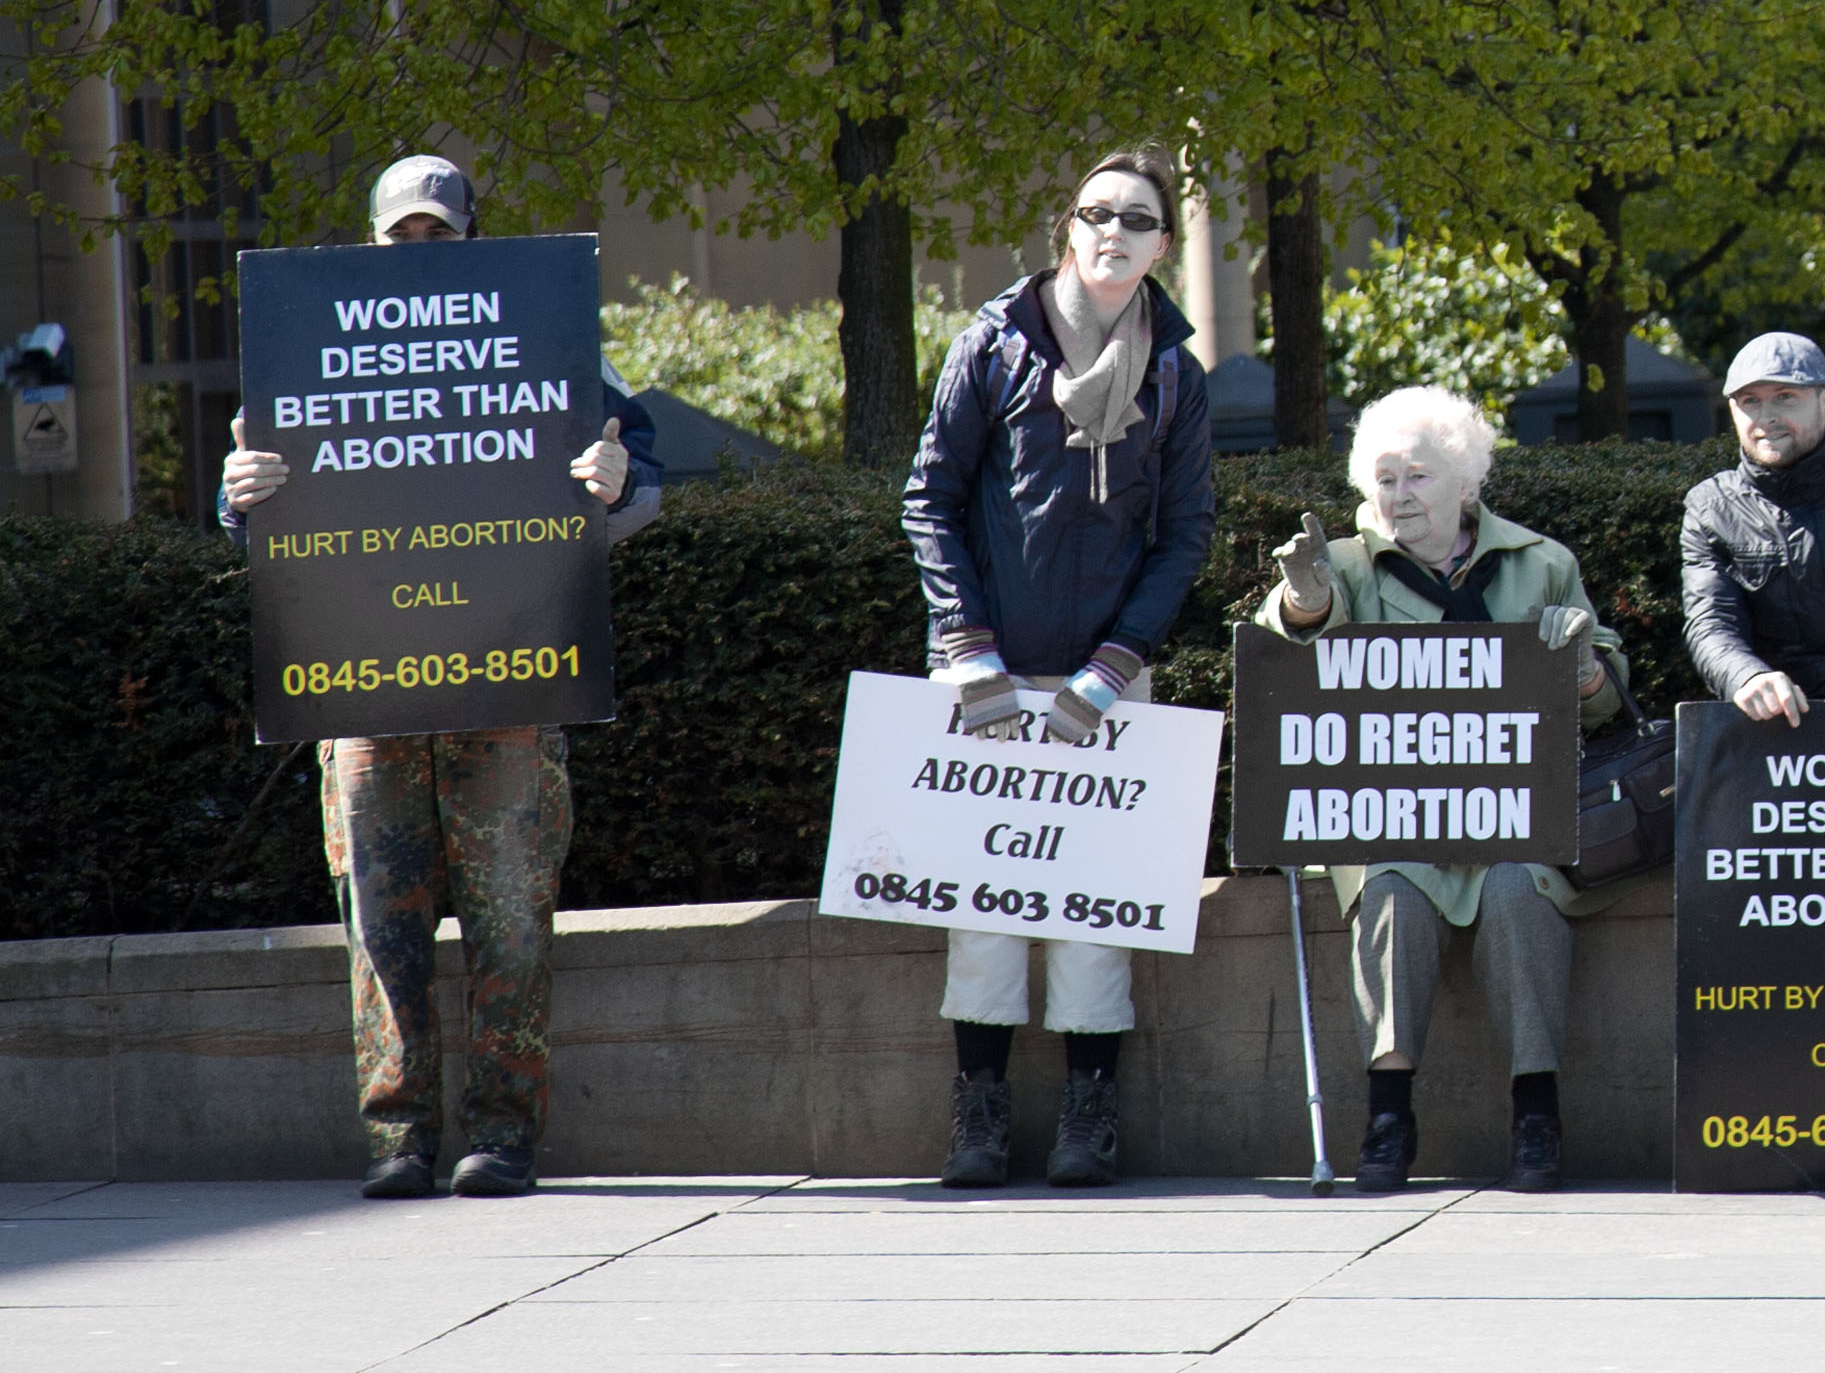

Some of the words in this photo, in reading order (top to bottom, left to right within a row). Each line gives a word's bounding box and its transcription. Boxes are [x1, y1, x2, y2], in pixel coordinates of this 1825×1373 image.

[335, 291, 500, 331] WOMEN
[320, 336, 520, 379] DESERVE
[274, 387, 443, 428] BETTER
[452, 379, 569, 417] THAN
[311, 428, 535, 473] ABORTION
[268, 530, 353, 559] HURT
[361, 527, 401, 553] BY
[408, 515, 586, 550] ABORTION?
[391, 582, 469, 608] CALL
[282, 645, 579, 696] 0845-603-8501
[1315, 637, 1503, 690] WOMEN
[1280, 712, 1347, 765] DO
[1359, 712, 1540, 765] REGRET
[911, 758, 1147, 811] ABORTION?
[1283, 787, 1531, 841] ABORTION
[984, 824, 1065, 861] Call
[854, 872, 960, 913] 0845
[971, 883, 1050, 922] 603
[1062, 892, 1166, 931] 8501
[1695, 987, 1777, 1011] HURT
[1785, 986, 1823, 1010] BY
